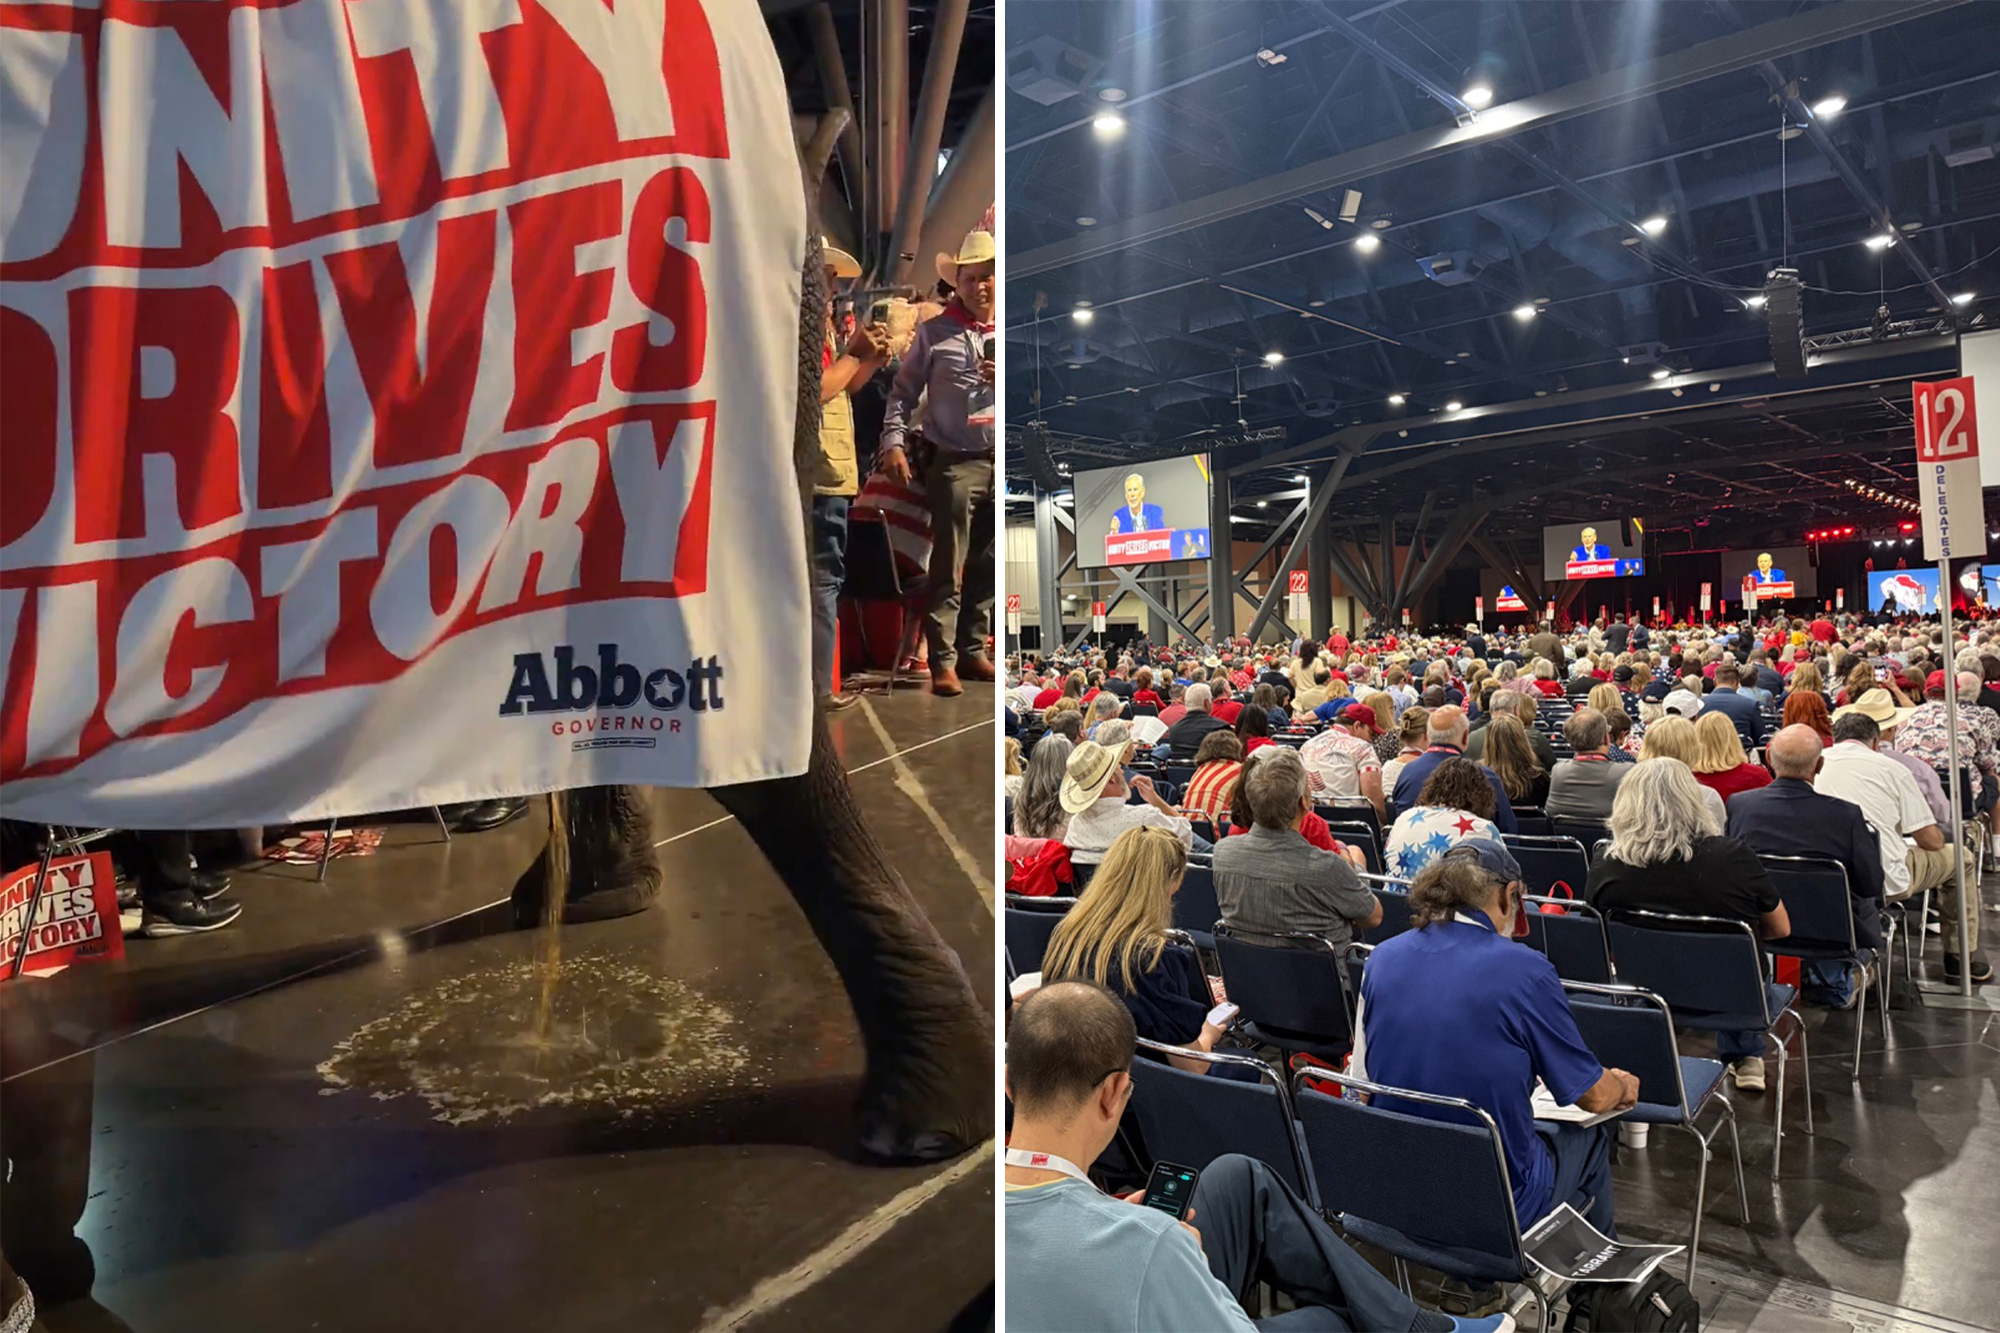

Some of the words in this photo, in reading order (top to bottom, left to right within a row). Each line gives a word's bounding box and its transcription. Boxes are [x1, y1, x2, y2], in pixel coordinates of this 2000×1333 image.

[1919, 387, 1968, 457] 12
[1935, 464, 1950, 557] DELEGATES
[0, 417, 707, 769] ICTORY
[1292, 573, 1306, 592] 22
[499, 643, 724, 715] Abbott
[552, 716, 682, 736] GOVERNOR
[0, 888, 94, 940] RIVES
[0, 915, 96, 961] ICTORY
[1571, 1245, 1621, 1277] TARRANT
